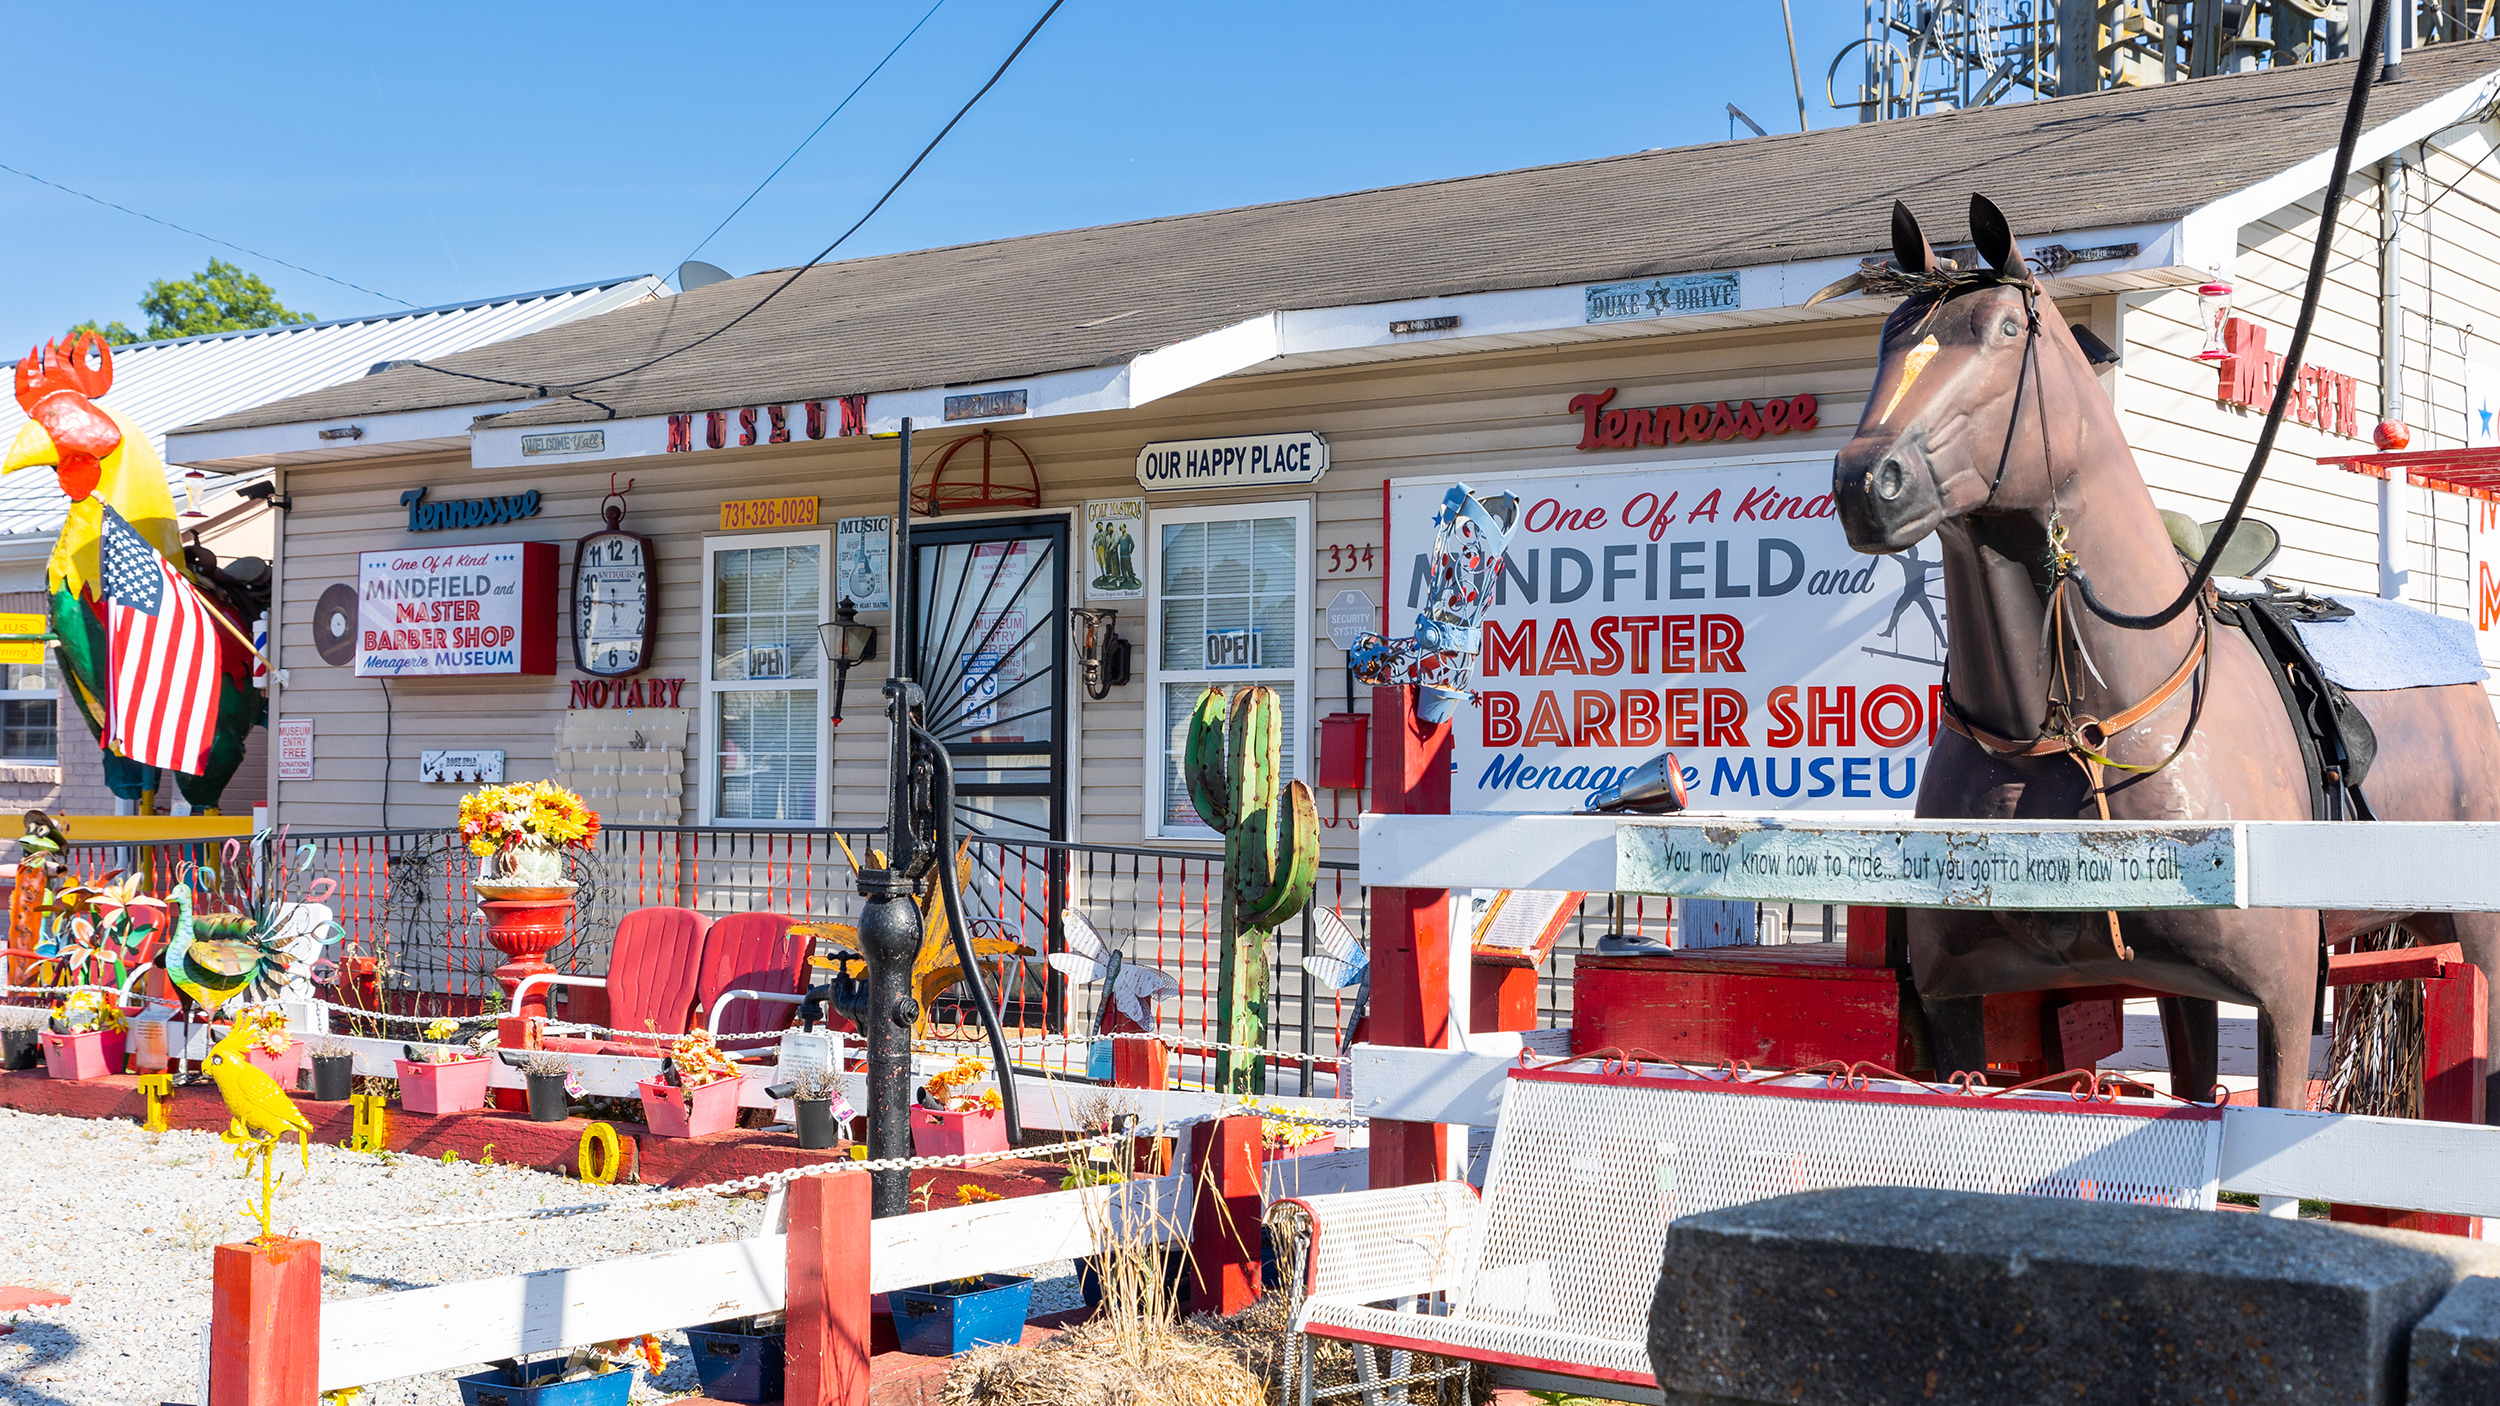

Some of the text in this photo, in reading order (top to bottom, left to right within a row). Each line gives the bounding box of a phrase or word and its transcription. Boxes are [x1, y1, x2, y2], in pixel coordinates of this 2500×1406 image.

[1591, 284, 1734, 318] DUKE DRIVE
[666, 395, 868, 453] MUSEUM
[1568, 387, 1820, 451] Tennessee
[524, 433, 599, 453] WELCOME Y'all
[1145, 442, 1311, 480] OUR HAPPY PLACE
[400, 486, 542, 532] Tennessee
[725, 498, 814, 528] 731-326-0029
[1088, 502, 1108, 522] GOLF
[1524, 498, 1608, 533] One
[1621, 491, 1679, 542] Of
[1688, 488, 1722, 525] A
[840, 518, 888, 534] MUSIC
[590, 546, 601, 567] 11
[607, 540, 623, 561] 12
[631, 545, 639, 566] 1
[1328, 543, 1373, 572] 334
[392, 553, 489, 573] One Of A Kind
[584, 574, 598, 593] 10
[597, 570, 636, 580] ANTIQUES
[637, 572, 645, 592] 2
[1808, 555, 1879, 596] and
[366, 575, 491, 600] MINDFIELD
[493, 581, 515, 595] and
[396, 600, 480, 623] MASTER
[583, 595, 591, 616] 9
[638, 594, 646, 614] 3
[583, 619, 592, 639] 8
[636, 617, 644, 635] 4
[975, 617, 1022, 630] MUSEUM
[1331, 613, 1370, 624] SECURITY
[364, 626, 515, 651] BARBER SHOP
[981, 630, 1016, 642] ENTRY
[1482, 613, 1748, 677] MASTER
[609, 648, 618, 667] 6
[629, 642, 638, 662] 5
[981, 644, 1016, 655] FREE
[1207, 634, 1258, 665] OPEN
[363, 651, 513, 674] Menagerie MUSEUM
[749, 650, 784, 676] OPEN
[568, 678, 686, 709] NOTARY
[1481, 688, 1751, 748] BARBER
[279, 726, 311, 736] MUSEUM
[283, 737, 306, 746] ENTRY
[283, 748, 306, 757] FREE
[1710, 756, 1916, 800] MUSEU
[1664, 842, 2184, 890] You may know how to ride... but you gotta know how to fall.
